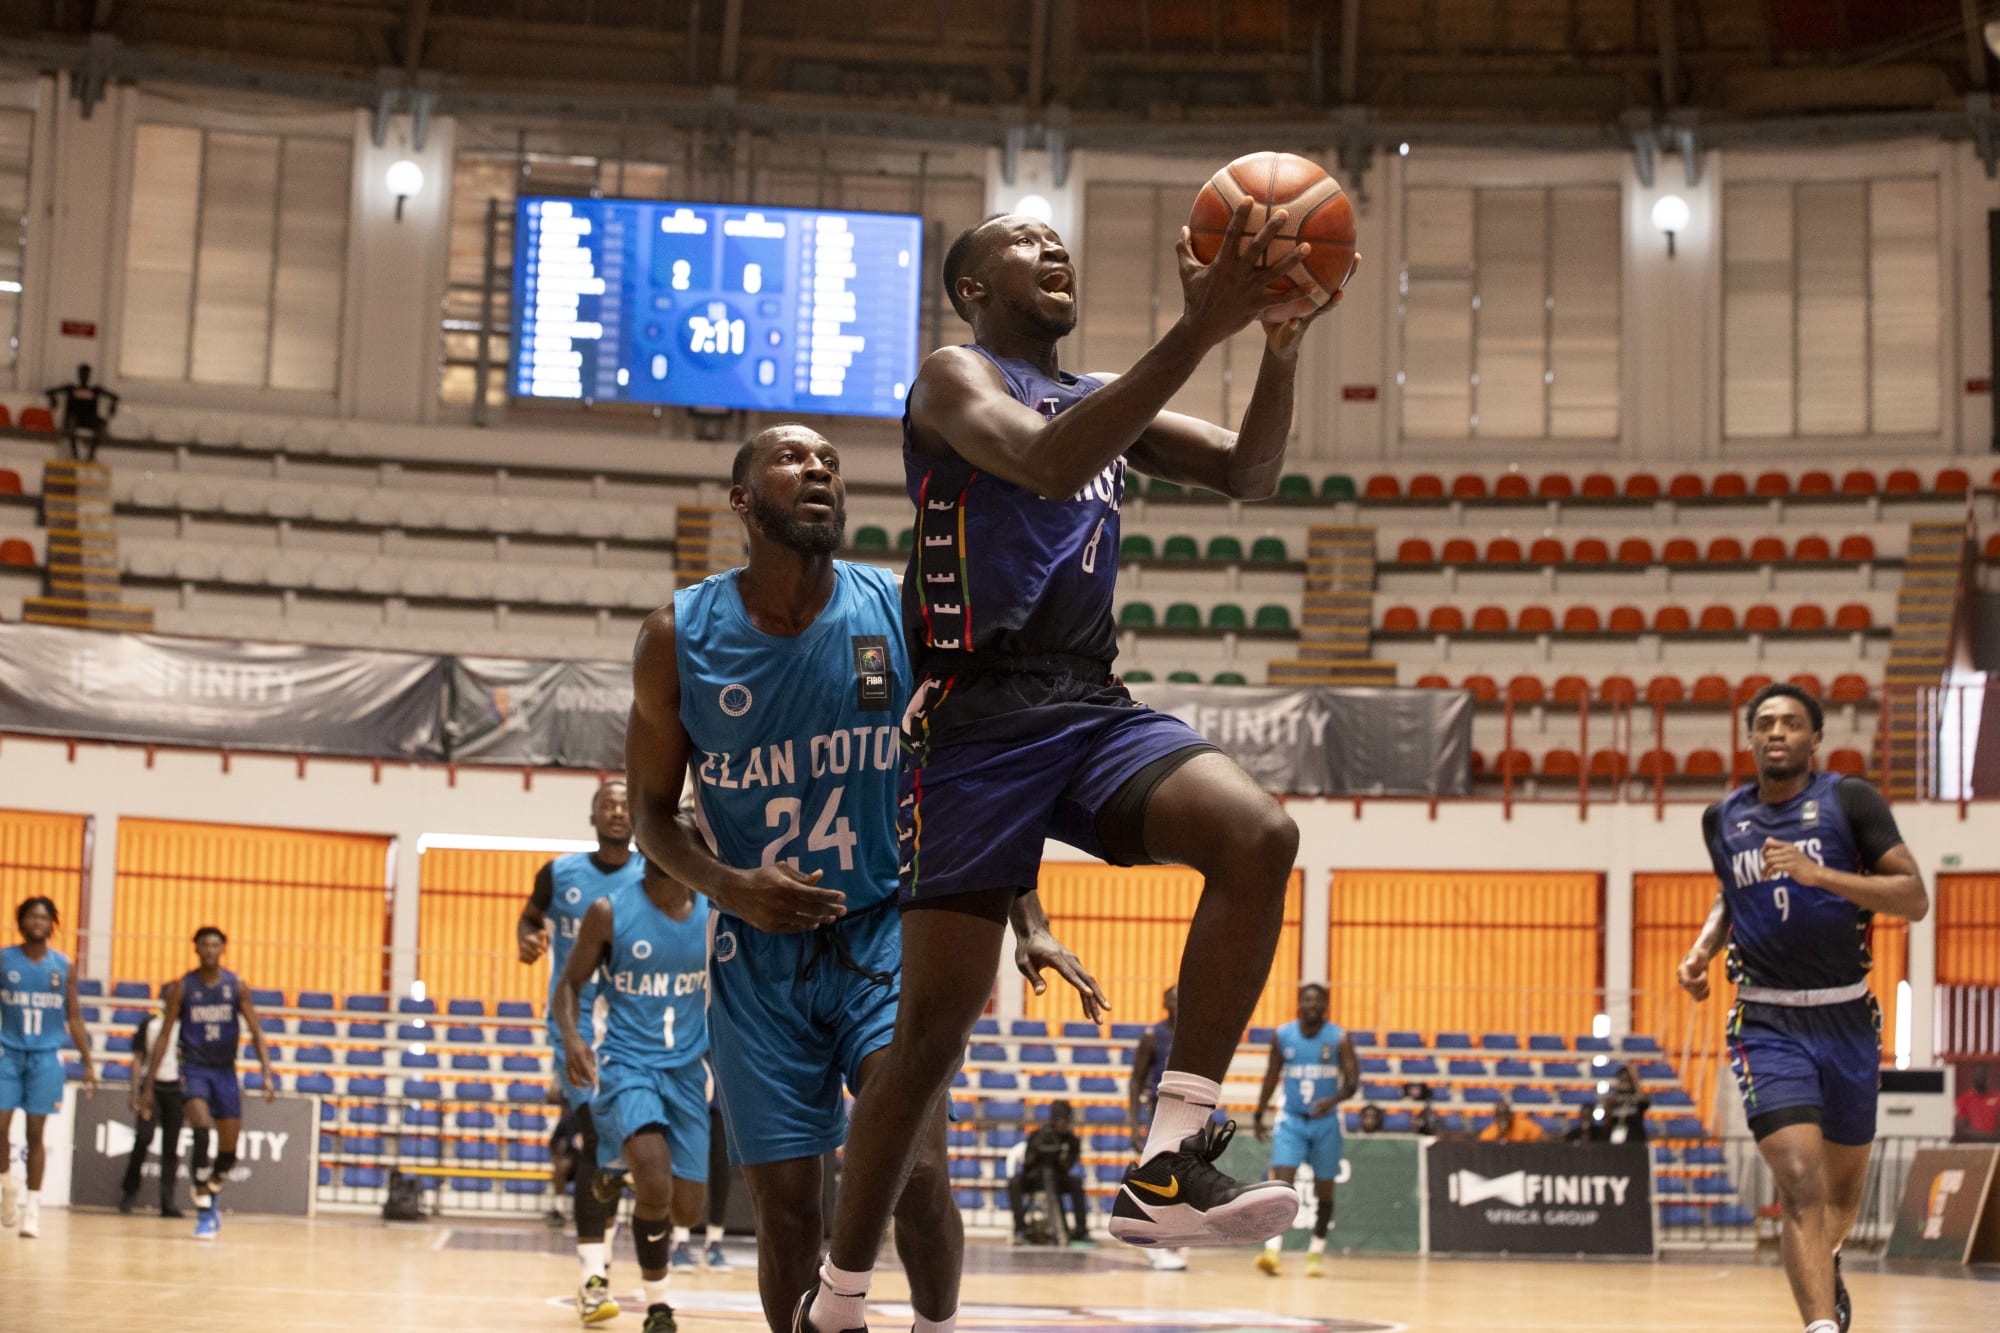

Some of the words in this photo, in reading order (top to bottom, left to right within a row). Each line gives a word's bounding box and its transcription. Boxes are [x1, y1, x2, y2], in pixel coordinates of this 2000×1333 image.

[689, 316, 745, 354] 7:11
[866, 676, 883, 686] FIBA
[700, 739, 796, 789] ELAN
[760, 785, 857, 872] 24
[1773, 886, 1790, 923] 9
[615, 971, 670, 997] ELAN
[23, 1008, 43, 1036] 11
[663, 1006, 675, 1049] 1
